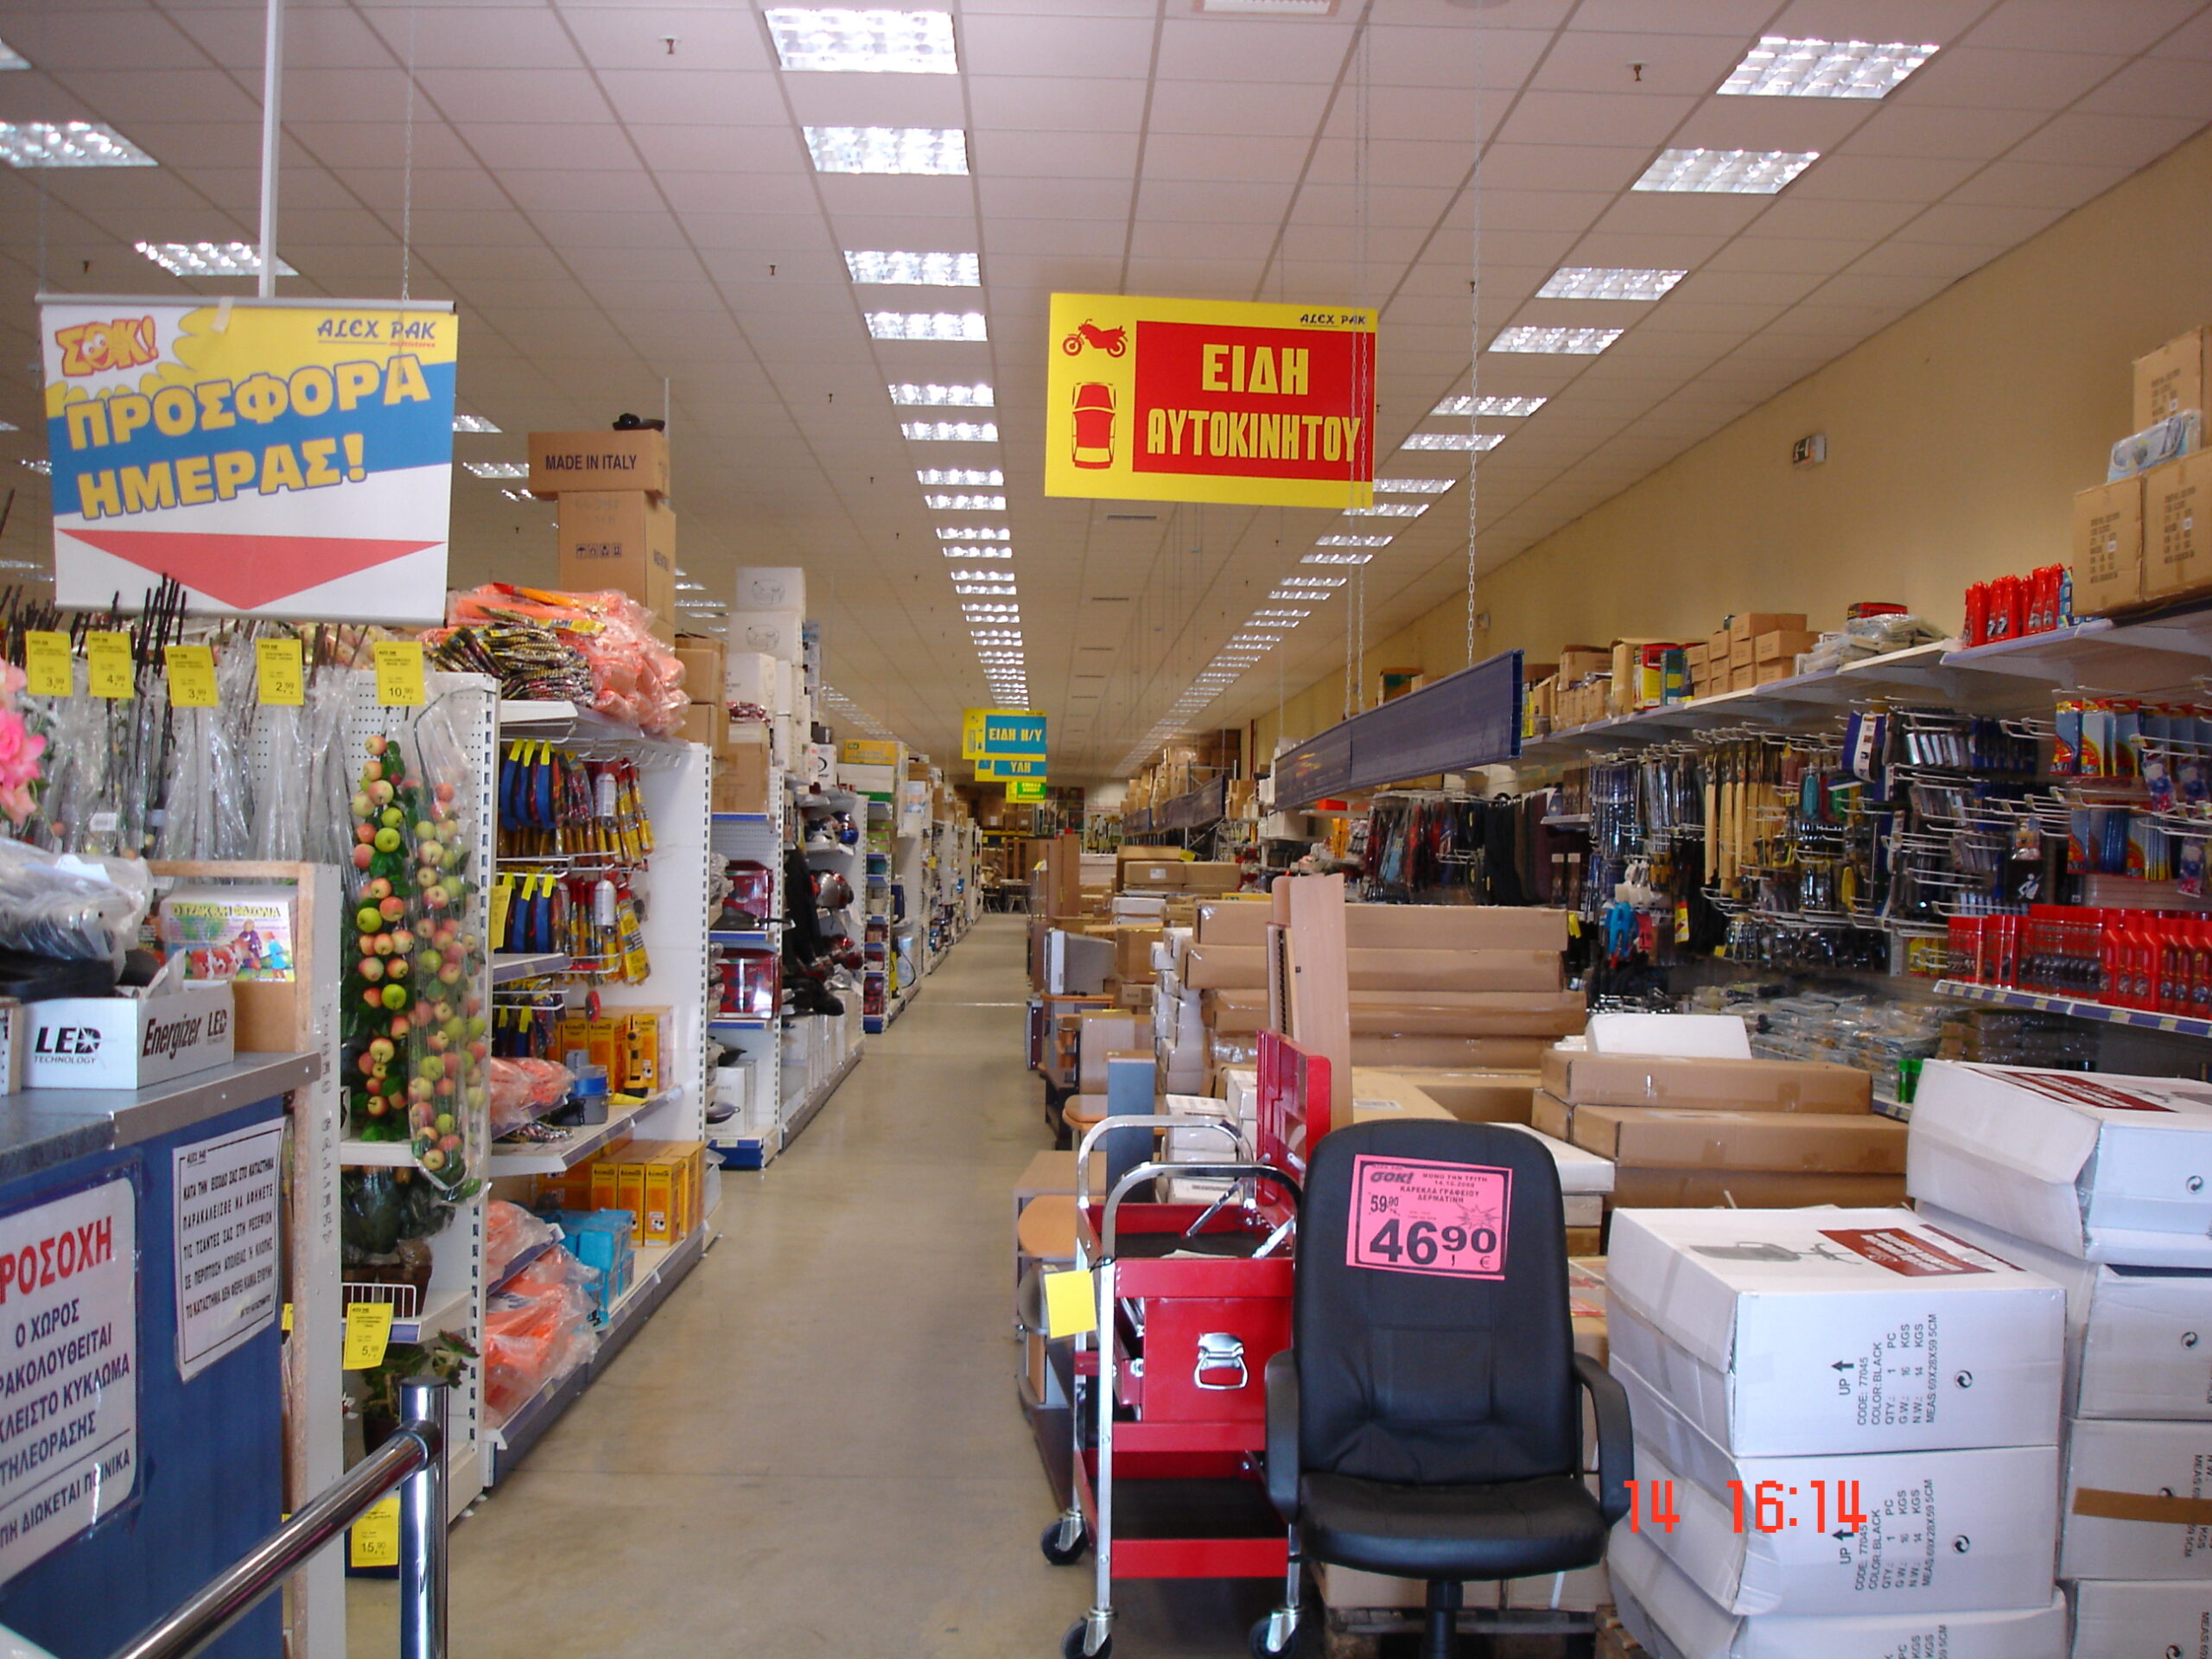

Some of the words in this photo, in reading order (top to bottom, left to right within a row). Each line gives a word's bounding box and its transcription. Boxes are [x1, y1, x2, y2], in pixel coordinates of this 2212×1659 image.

[317, 319, 379, 338] ALEX
[391, 321, 436, 339] PAK
[1300, 314, 1335, 325] ALEX
[1341, 315, 1366, 325] PAK
[1202, 344, 1309, 396] ΕΙΔΗ
[66, 353, 431, 449] ΠΡΟΣΦΟΡΑ
[1147, 409, 1363, 462] ΑΥΤΟΚΙΝΗΤΟΥ
[545, 454, 583, 470] MADE
[587, 454, 599, 470] IN
[602, 454, 637, 470] ITALY
[77, 434, 368, 520] ΗΜΕΡΑΣ!
[989, 728, 1016, 741] ΕΙΔΗ
[35, 1027, 102, 1054] LED
[142, 1013, 203, 1060] Energizer
[207, 1009, 227, 1037] LED
[34, 1055, 97, 1065] TECHNOLOGY
[1400, 1185, 1438, 1194] ΚΑΡΕΚΛΑ
[1439, 1187, 1480, 1198] ΓΡΑΦΕΙΟΥ
[1417, 1193, 1465, 1204] ΔΕΡΜΑΤΙΝΗ
[16, 1323, 26, 1348] Ο
[31, 1298, 79, 1343] ΧΩΡΟΣ
[1900, 1323, 1910, 1348] KGS
[1914, 1323, 1924, 1348] KGS
[1887, 1332, 1897, 1349] PC
[63, 1352, 130, 1408] ΚΥΚΛΩΜΑ
[1859, 1357, 1868, 1387] 77045
[1839, 1377, 1851, 1395] UP
[22, 1479, 80, 1534] ΔΙΩΚΕΤΑΙ
[1885, 1499, 1894, 1516] PC
[1897, 1490, 1908, 1515] KGS
[1910, 1489, 1921, 1514] KGS
[1859, 1524, 1868, 1555] 77045
[1840, 1547, 1851, 1565] UP
